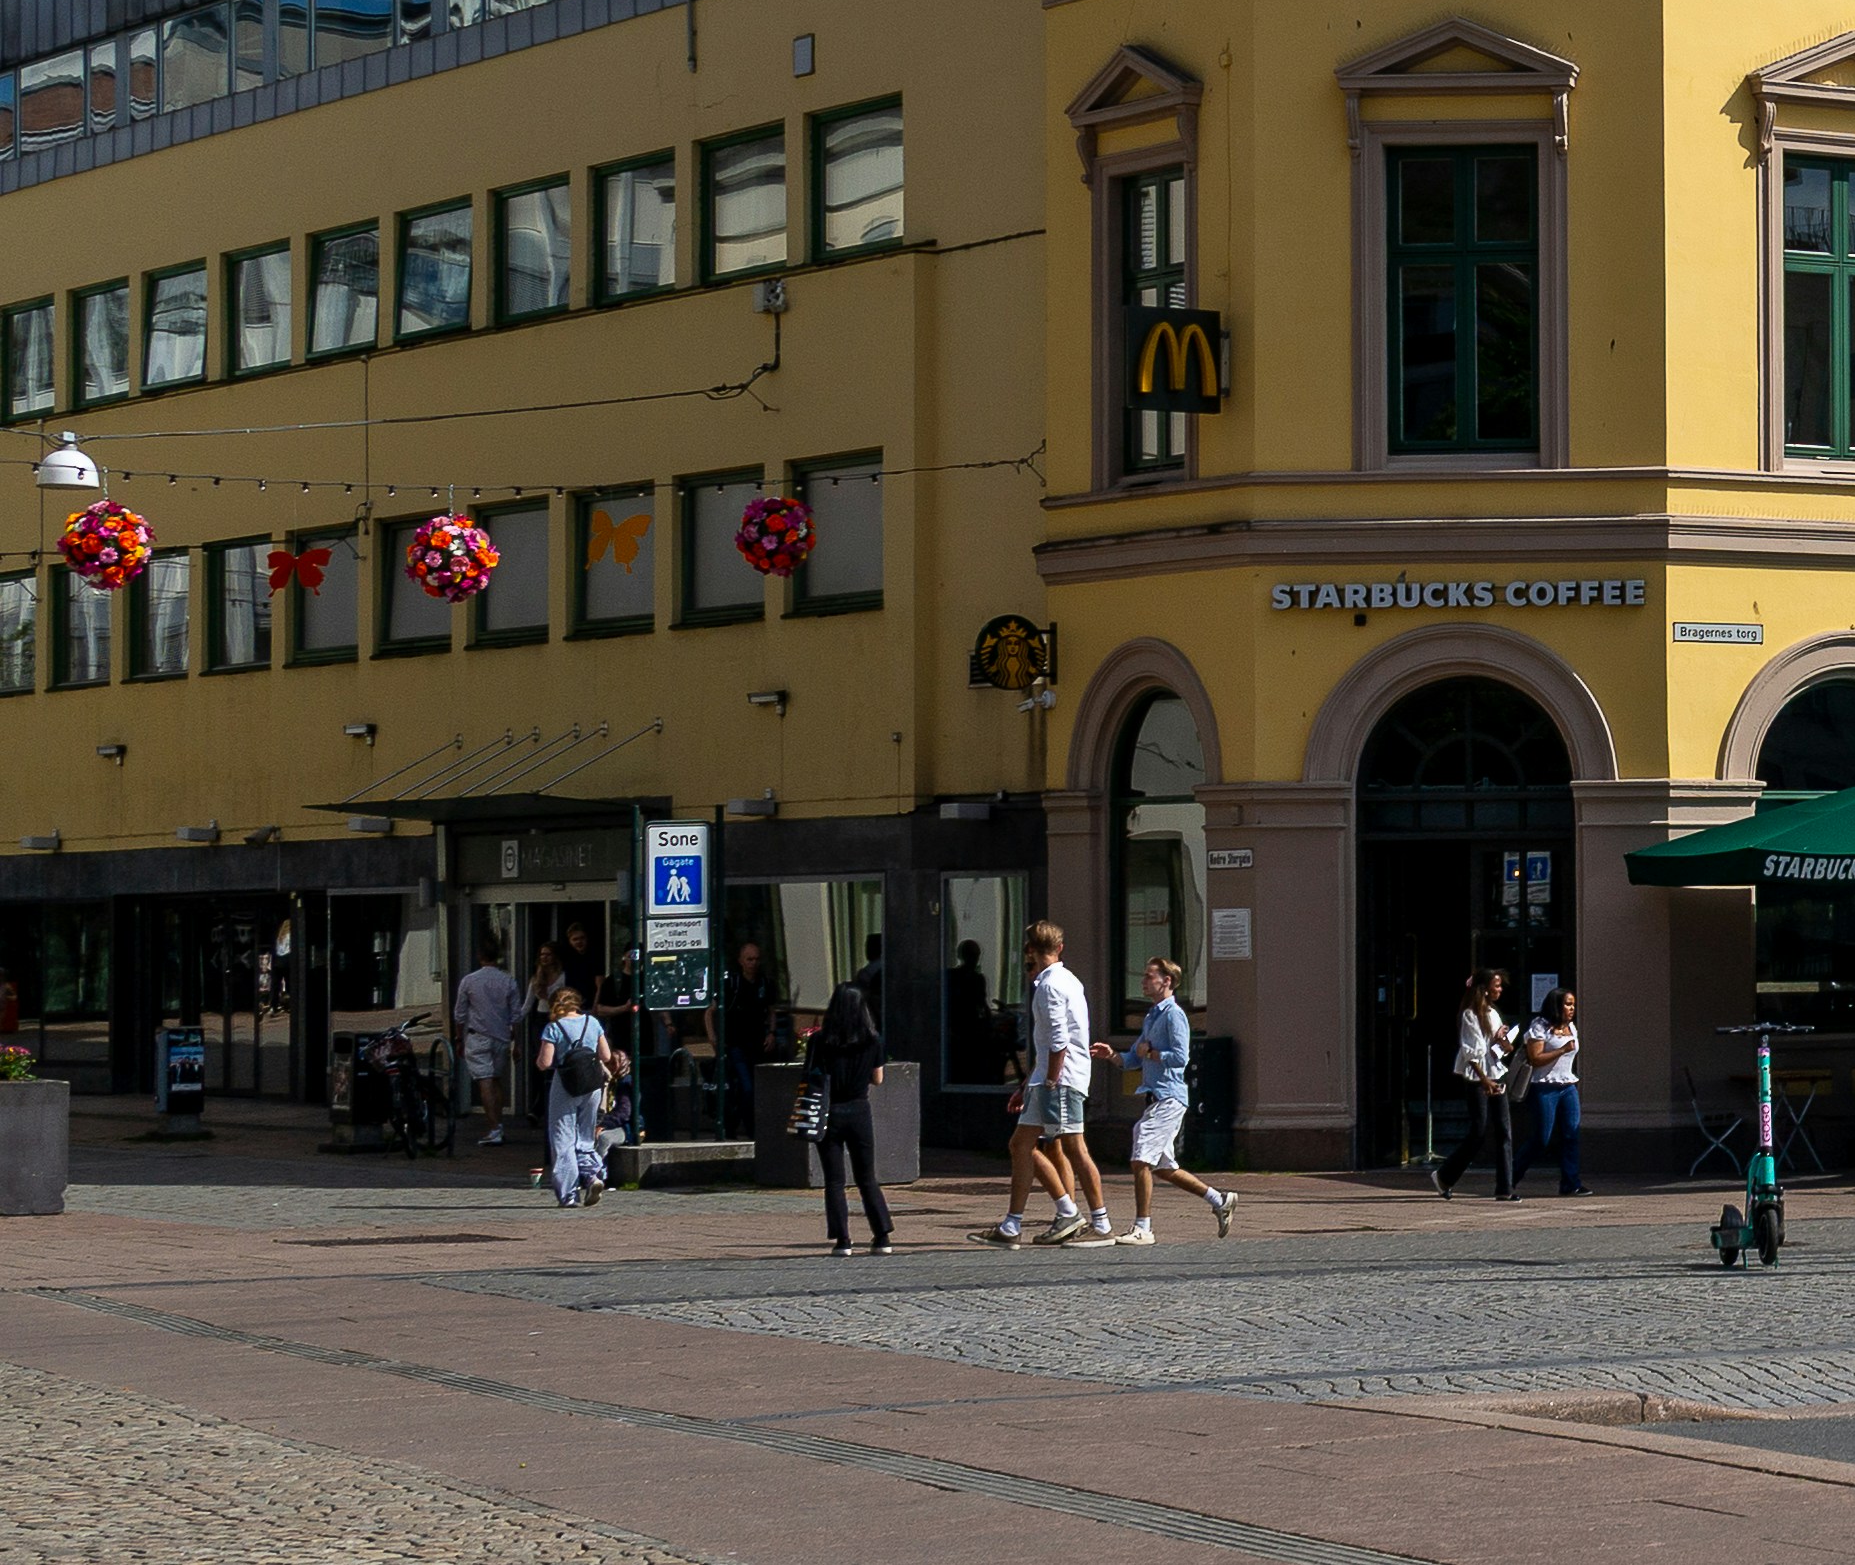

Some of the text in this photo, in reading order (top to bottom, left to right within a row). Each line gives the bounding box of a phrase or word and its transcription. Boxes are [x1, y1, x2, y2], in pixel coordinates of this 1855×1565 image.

[1271, 580, 1646, 609] STARBUCKS COFFEE
[1680, 626, 1757, 641] Bragernes torg
[657, 832, 699, 846] Sone
[1762, 1104, 1771, 1143] GOGO
